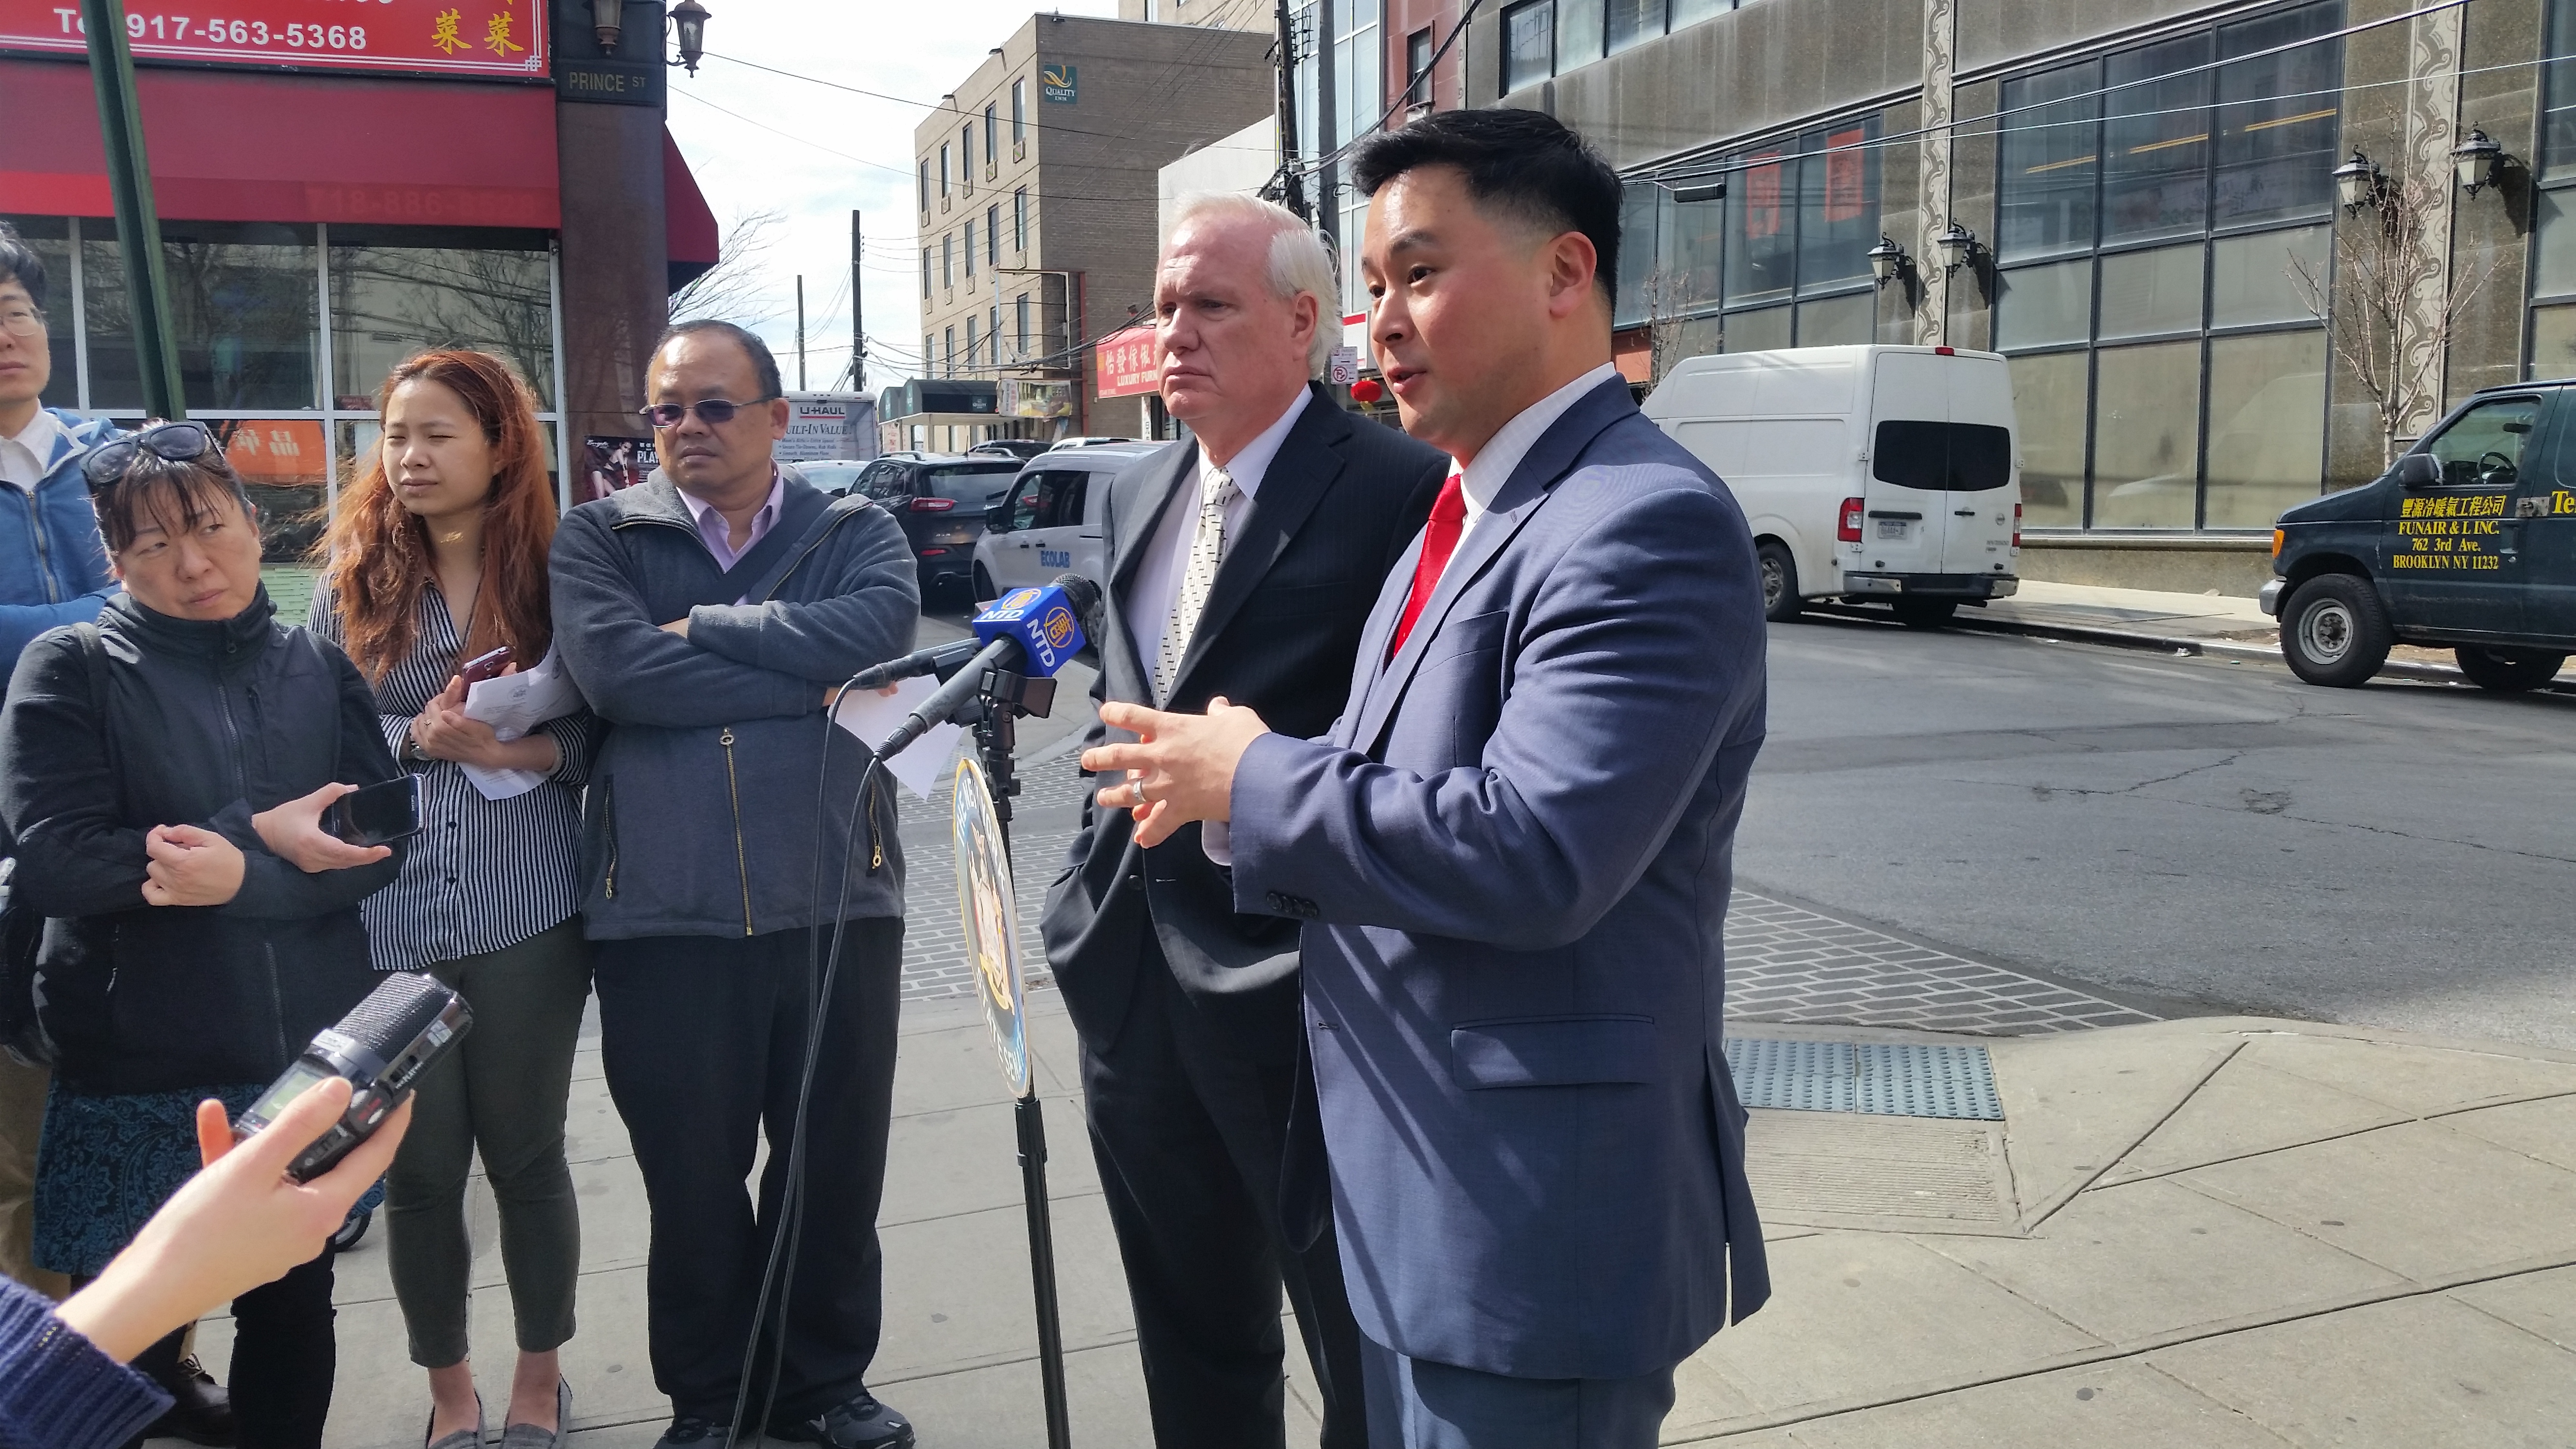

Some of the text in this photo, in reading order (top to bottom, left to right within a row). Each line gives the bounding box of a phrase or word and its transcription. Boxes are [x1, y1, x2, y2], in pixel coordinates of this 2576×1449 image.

[127, 14, 367, 49] 917-563-5368
[569, 72, 646, 92] PRINCE ST
[1046, 86, 1076, 97] QUALITY
[1117, 372, 1140, 386] LUXURY
[800, 406, 845, 415] U-HAUL
[786, 424, 819, 435] UILT-IN
[2552, 491, 2576, 514] Te
[2398, 520, 2500, 535] FUNAIR & L INC.
[2412, 538, 2481, 552] 762 3rd Ave.
[1041, 550, 1070, 568] ECOLAB
[2393, 555, 2499, 570] BROOKLYN NY 11232
[981, 610, 1024, 620] NTD
[1027, 618, 1056, 667] NTD
[956, 790, 968, 848] THE
[980, 795, 1005, 893] YORK
[977, 966, 1004, 1063] STATE
